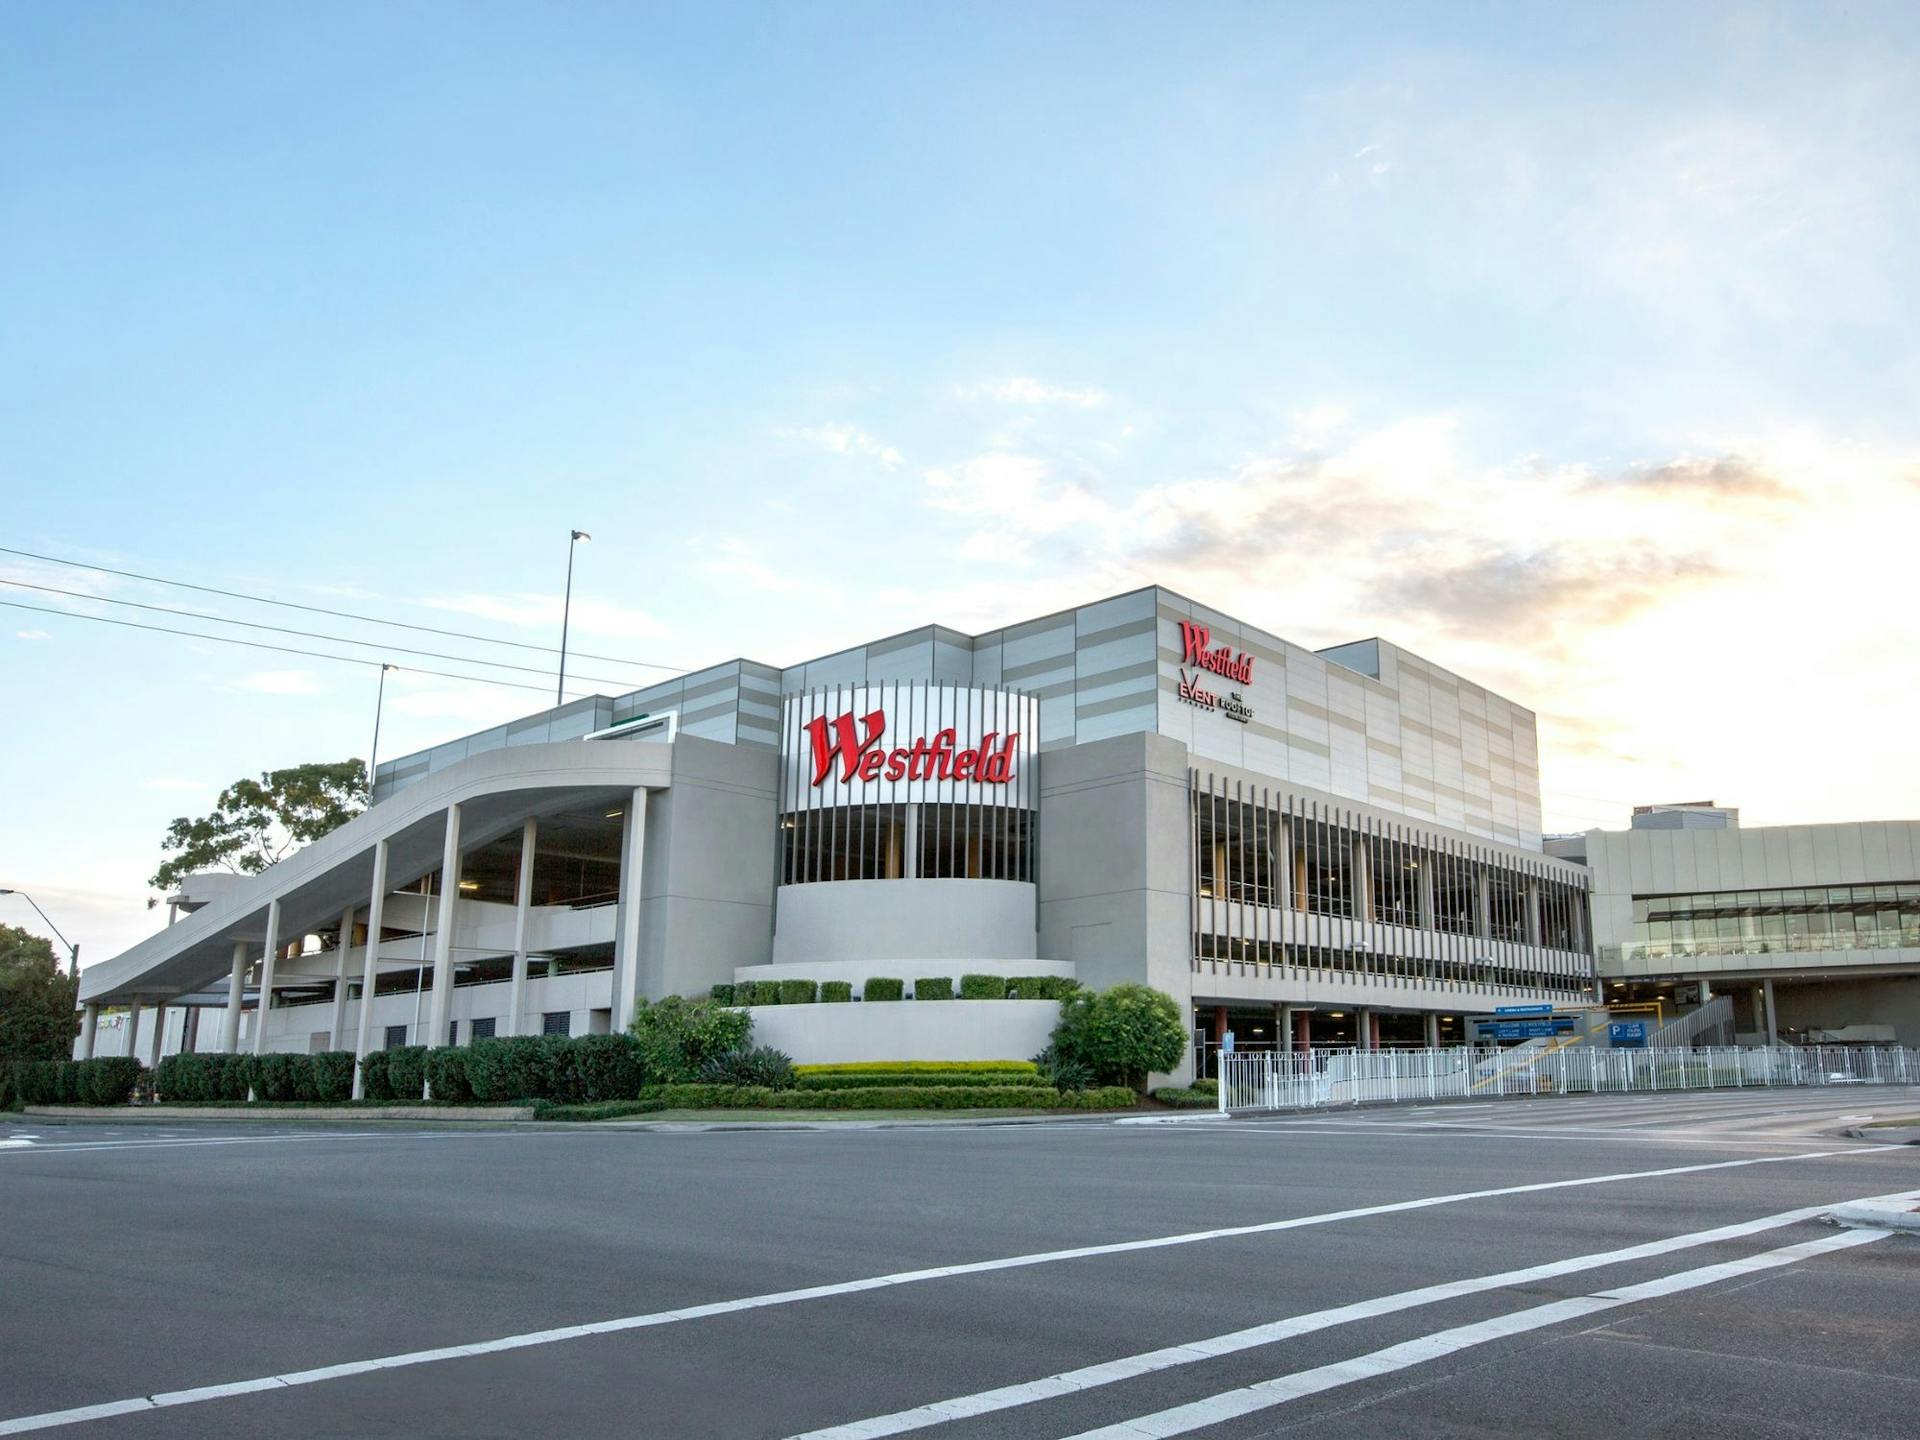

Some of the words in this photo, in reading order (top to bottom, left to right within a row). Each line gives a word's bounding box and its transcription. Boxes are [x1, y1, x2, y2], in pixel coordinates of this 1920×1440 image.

[1178, 620, 1256, 687] Westfield
[1178, 668, 1216, 707] EVENT
[803, 708, 1021, 787] Westfield
[1612, 1025, 1621, 1035] P
